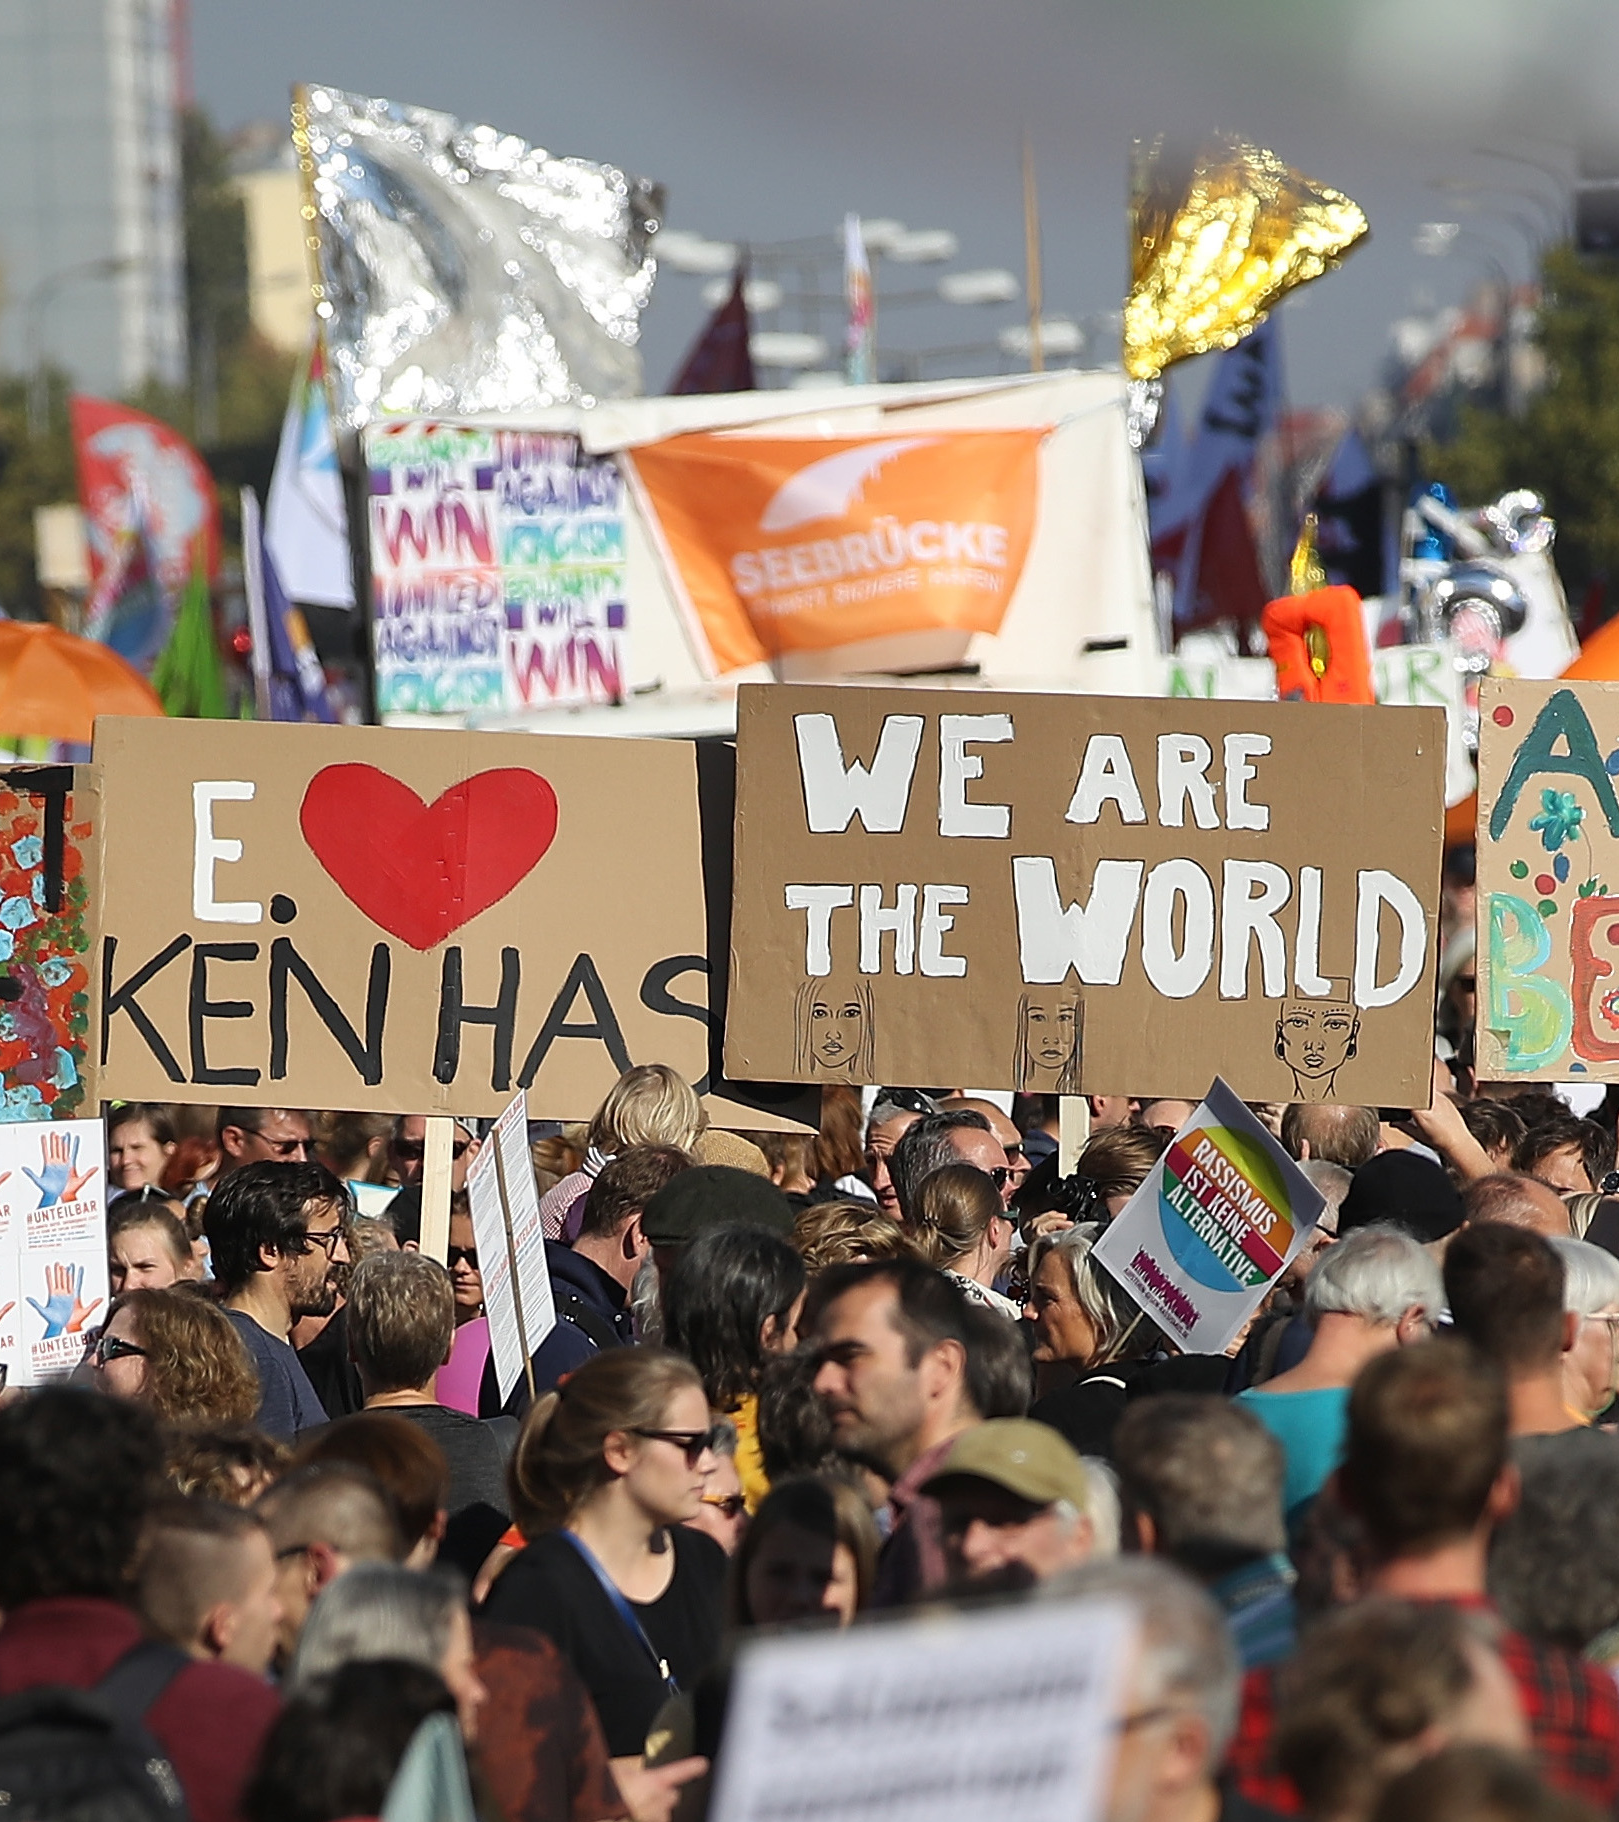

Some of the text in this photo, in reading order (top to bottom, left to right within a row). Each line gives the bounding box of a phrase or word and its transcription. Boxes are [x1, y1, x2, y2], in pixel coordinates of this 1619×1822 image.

[373, 494, 494, 567] WIN
[731, 515, 1008, 597] SEEBRÜCKE
[505, 633, 621, 704] WIN
[793, 712, 1273, 839] WE ARE
[784, 855, 1429, 1010] THE WORLD
[27, 1200, 97, 1225] #UNTEILBAR
[1182, 1164, 1252, 1245] IST KEINE
[1192, 1138, 1277, 1234] RASSISMUS
[1166, 1183, 1258, 1287] ALTERNATIVE
